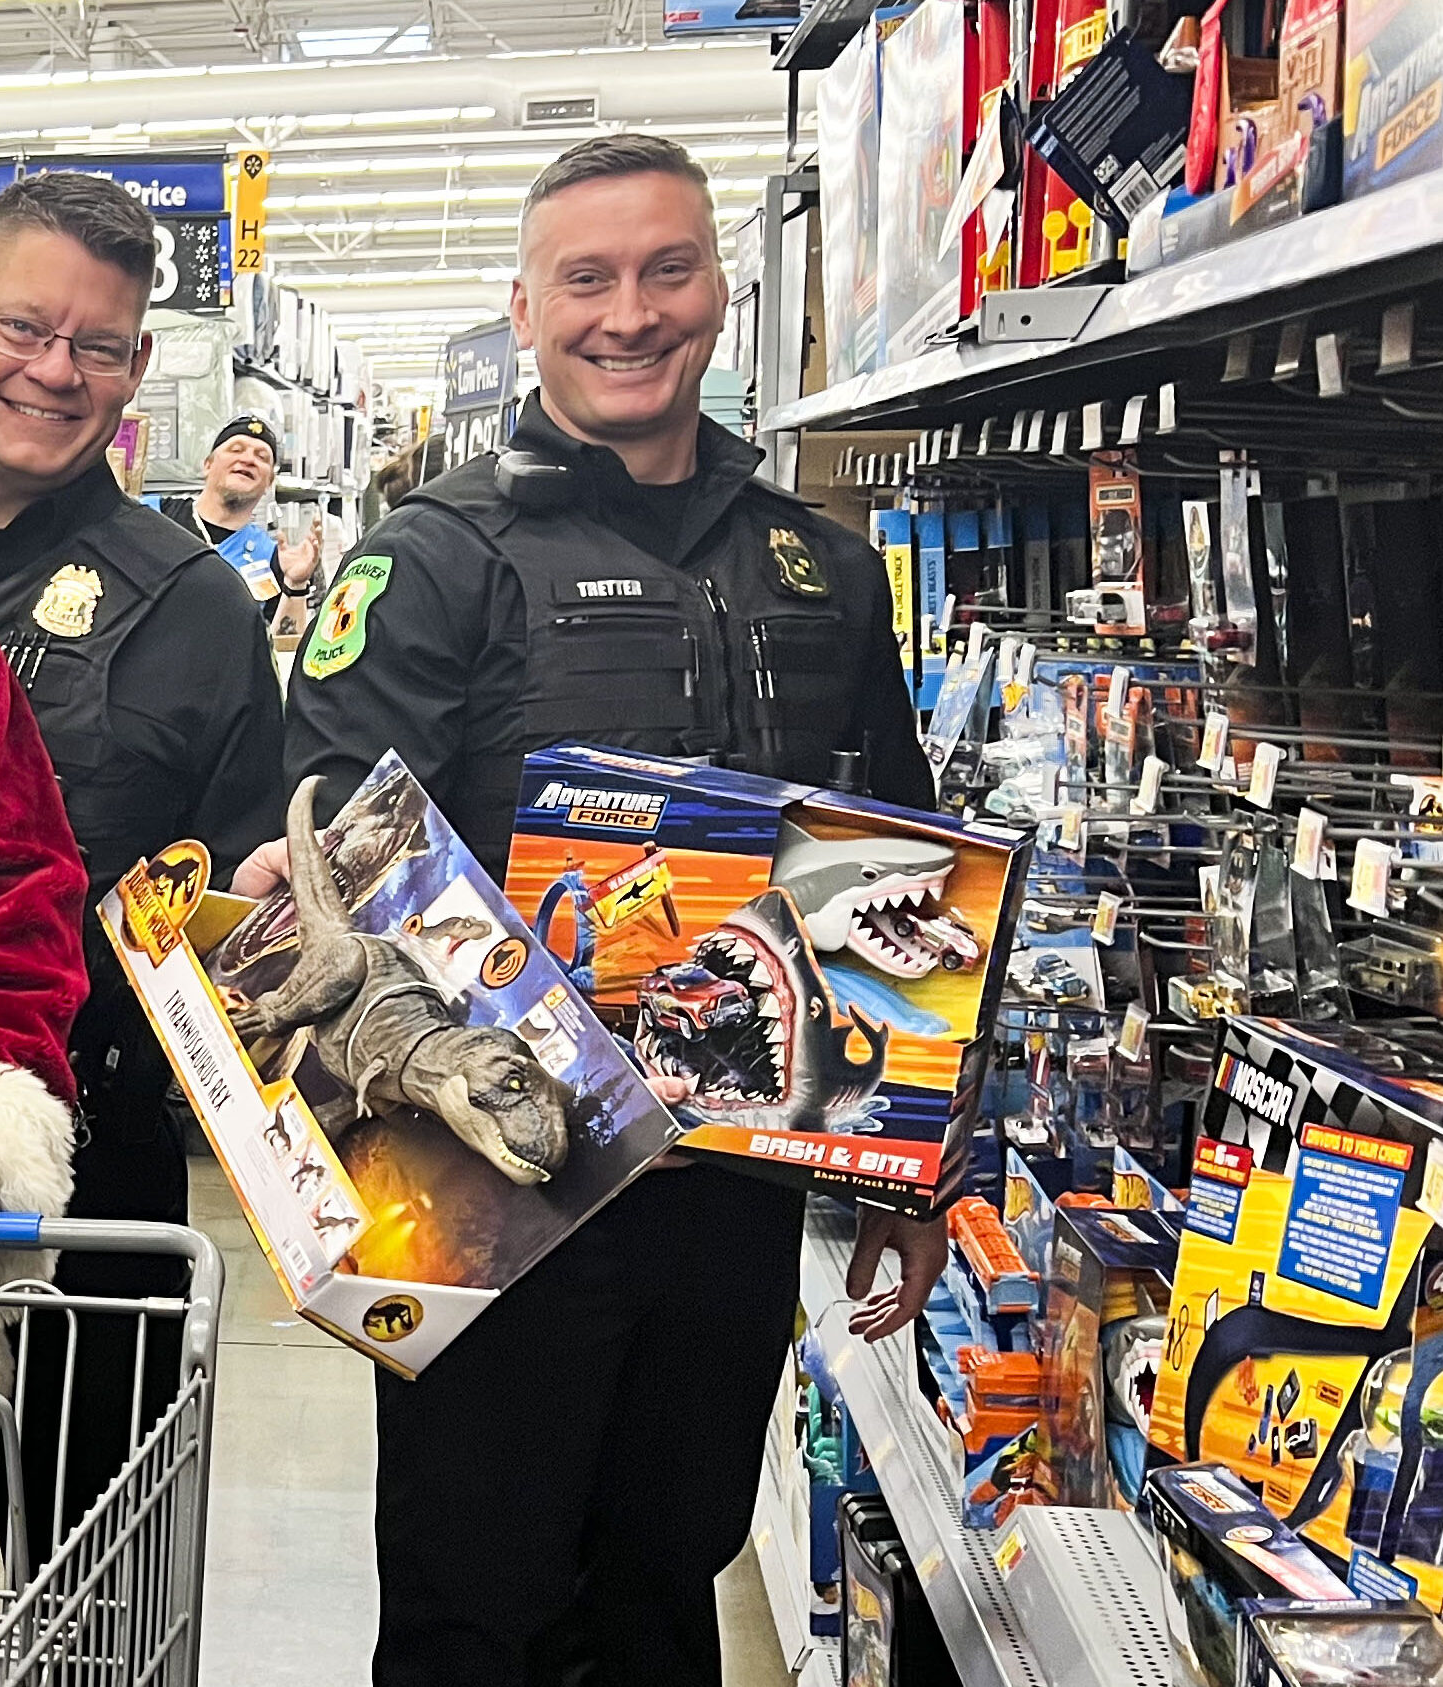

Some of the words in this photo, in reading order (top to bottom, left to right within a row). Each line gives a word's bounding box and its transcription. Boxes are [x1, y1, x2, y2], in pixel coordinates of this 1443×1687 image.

[124, 180, 187, 207] Price
[242, 220, 259, 240] H
[238, 249, 261, 268] 22
[458, 366, 477, 395] Low
[476, 357, 499, 392] Price
[577, 580, 642, 597] TRETTER
[314, 644, 345, 660] POLICE
[533, 782, 665, 813] ADVENTURE
[577, 810, 649, 826] FORCE
[126, 866, 153, 917] JURASSIC
[145, 911, 174, 953] WORLD
[164, 989, 219, 1087] TYRANNOSAURUS
[208, 1077, 231, 1113] REX
[1230, 1060, 1293, 1127] NASCAR
[749, 1134, 826, 1163] BASH
[830, 1147, 852, 1167] &
[858, 1151, 922, 1178] BITE
[1342, 1136, 1354, 1154] TO
[852, 1176, 883, 1188] Track
